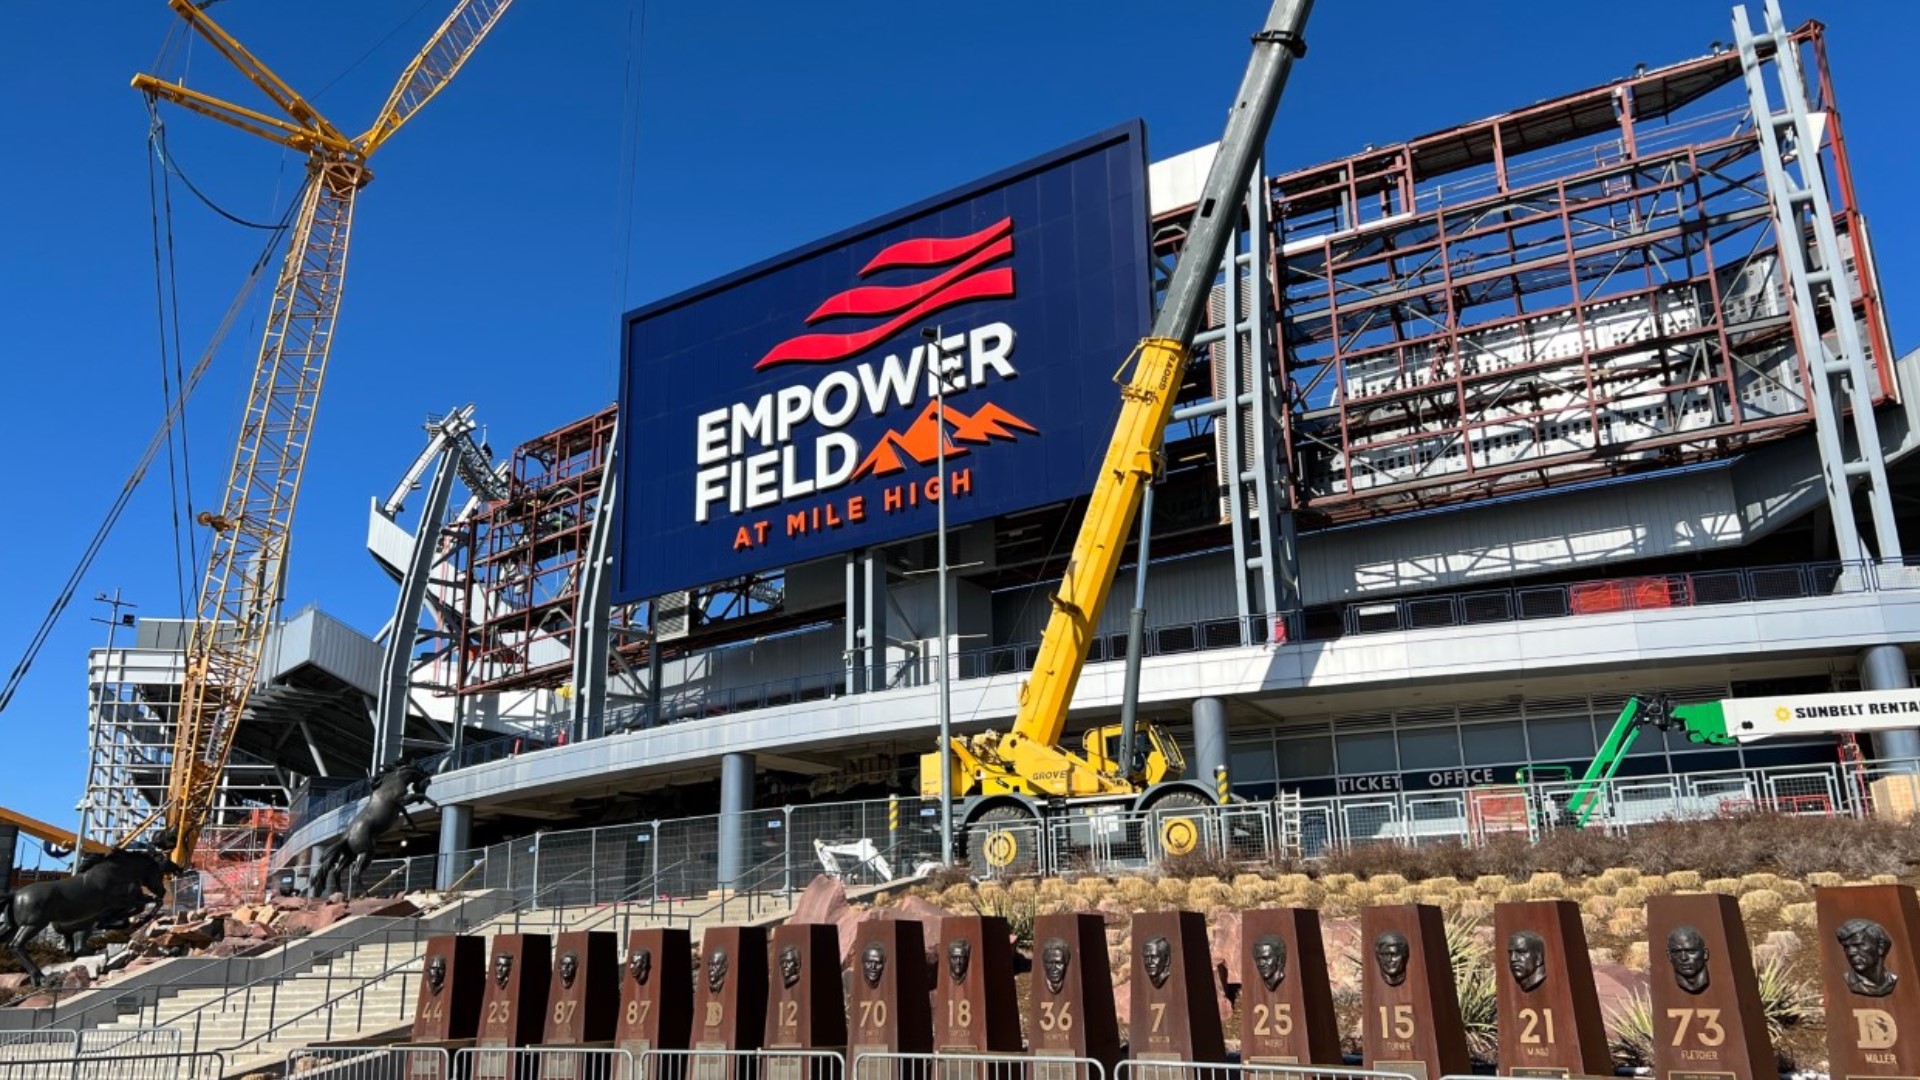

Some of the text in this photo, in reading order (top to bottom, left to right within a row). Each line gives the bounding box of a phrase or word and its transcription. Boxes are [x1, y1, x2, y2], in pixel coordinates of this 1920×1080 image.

[1158, 353, 1177, 391] GROVE
[697, 322, 1016, 465] EMPOWER
[695, 432, 859, 522] FIELD
[733, 468, 971, 549] AT MILE HIGH
[1795, 701, 1920, 719] SUNBELT RENTA
[1033, 770, 1067, 781] GROVE
[1339, 768, 1494, 792] TICKET OFFICE
[422, 1002, 443, 1023] 44
[487, 1001, 511, 1023] 23
[553, 1000, 577, 1024] 87
[626, 1000, 651, 1024] 87
[778, 1001, 797, 1026] 12
[859, 1000, 887, 1028] 70
[948, 1000, 971, 1027] 18
[1039, 1002, 1072, 1031] 36
[1150, 1003, 1166, 1032] 7
[1254, 1003, 1293, 1035] 25
[1379, 1005, 1415, 1039] 15
[1518, 1008, 1555, 1043] 21
[1667, 1008, 1725, 1046] 73
[1681, 1050, 1718, 1060] FLETCHER
[1865, 1053, 1897, 1064] MILLER
